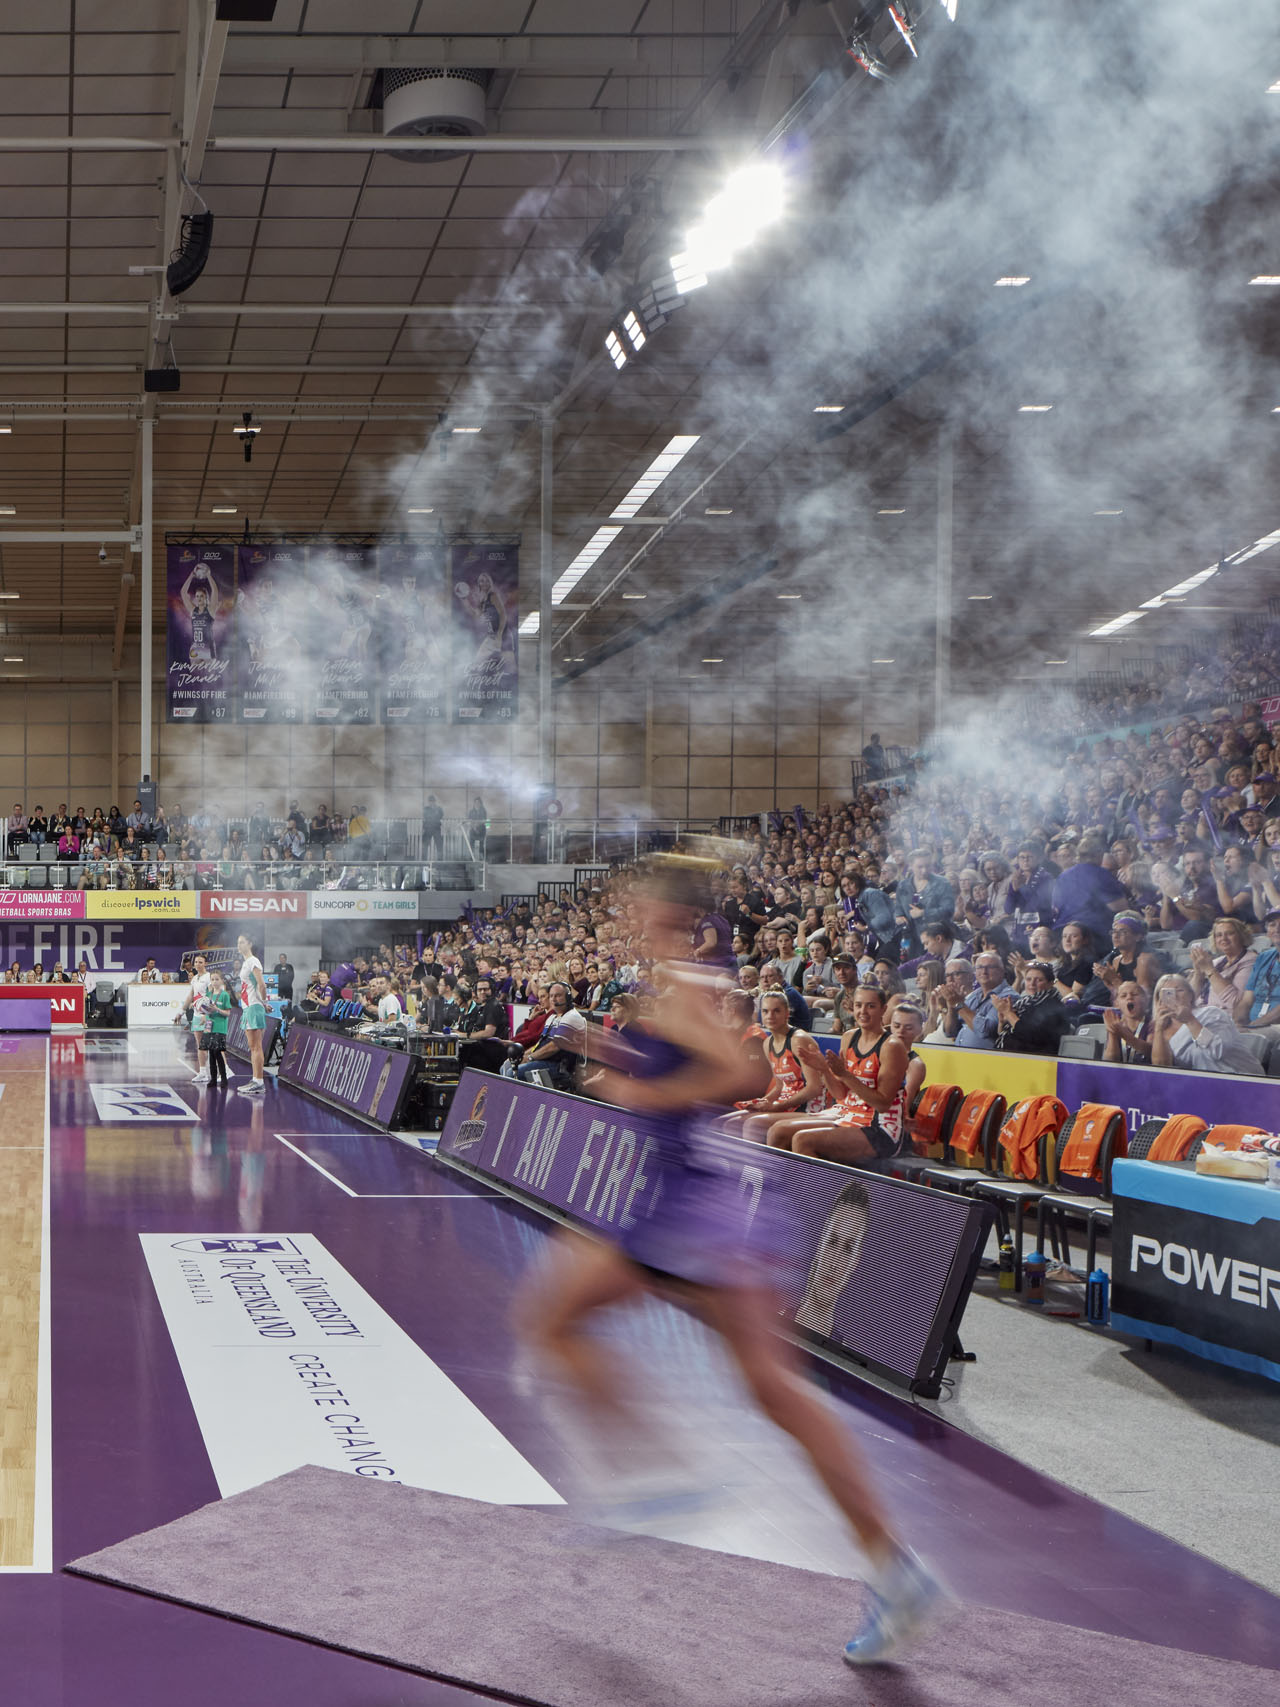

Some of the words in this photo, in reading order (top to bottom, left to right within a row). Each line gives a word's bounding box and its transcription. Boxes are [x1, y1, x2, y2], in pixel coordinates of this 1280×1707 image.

[169, 659, 230, 674] Kimberley
[177, 673, 221, 687] Jenner
[18, 892, 81, 904] LORNAJANE.COM
[210, 897, 298, 912] NISSAN
[314, 900, 355, 909] SUNCORP
[373, 901, 394, 909] TEAM
[396, 901, 416, 909] GIRLS
[28, 908, 52, 916] SPORTS
[54, 908, 71, 916] BRAS
[303, 1038, 326, 1083] AM
[319, 1043, 372, 1104] FIREBIRD
[491, 1096, 518, 1168] I
[514, 1103, 569, 1190] AM
[219, 1258, 257, 1271] OF
[271, 1258, 310, 1276] THE
[178, 1259, 214, 1306] AUSTRALIA
[220, 1271, 297, 1339] QUEENSLAND
[286, 1276, 365, 1338] UNIVERSITY
[288, 1353, 350, 1407] CREATE
[324, 1413, 404, 1485] CHANG
